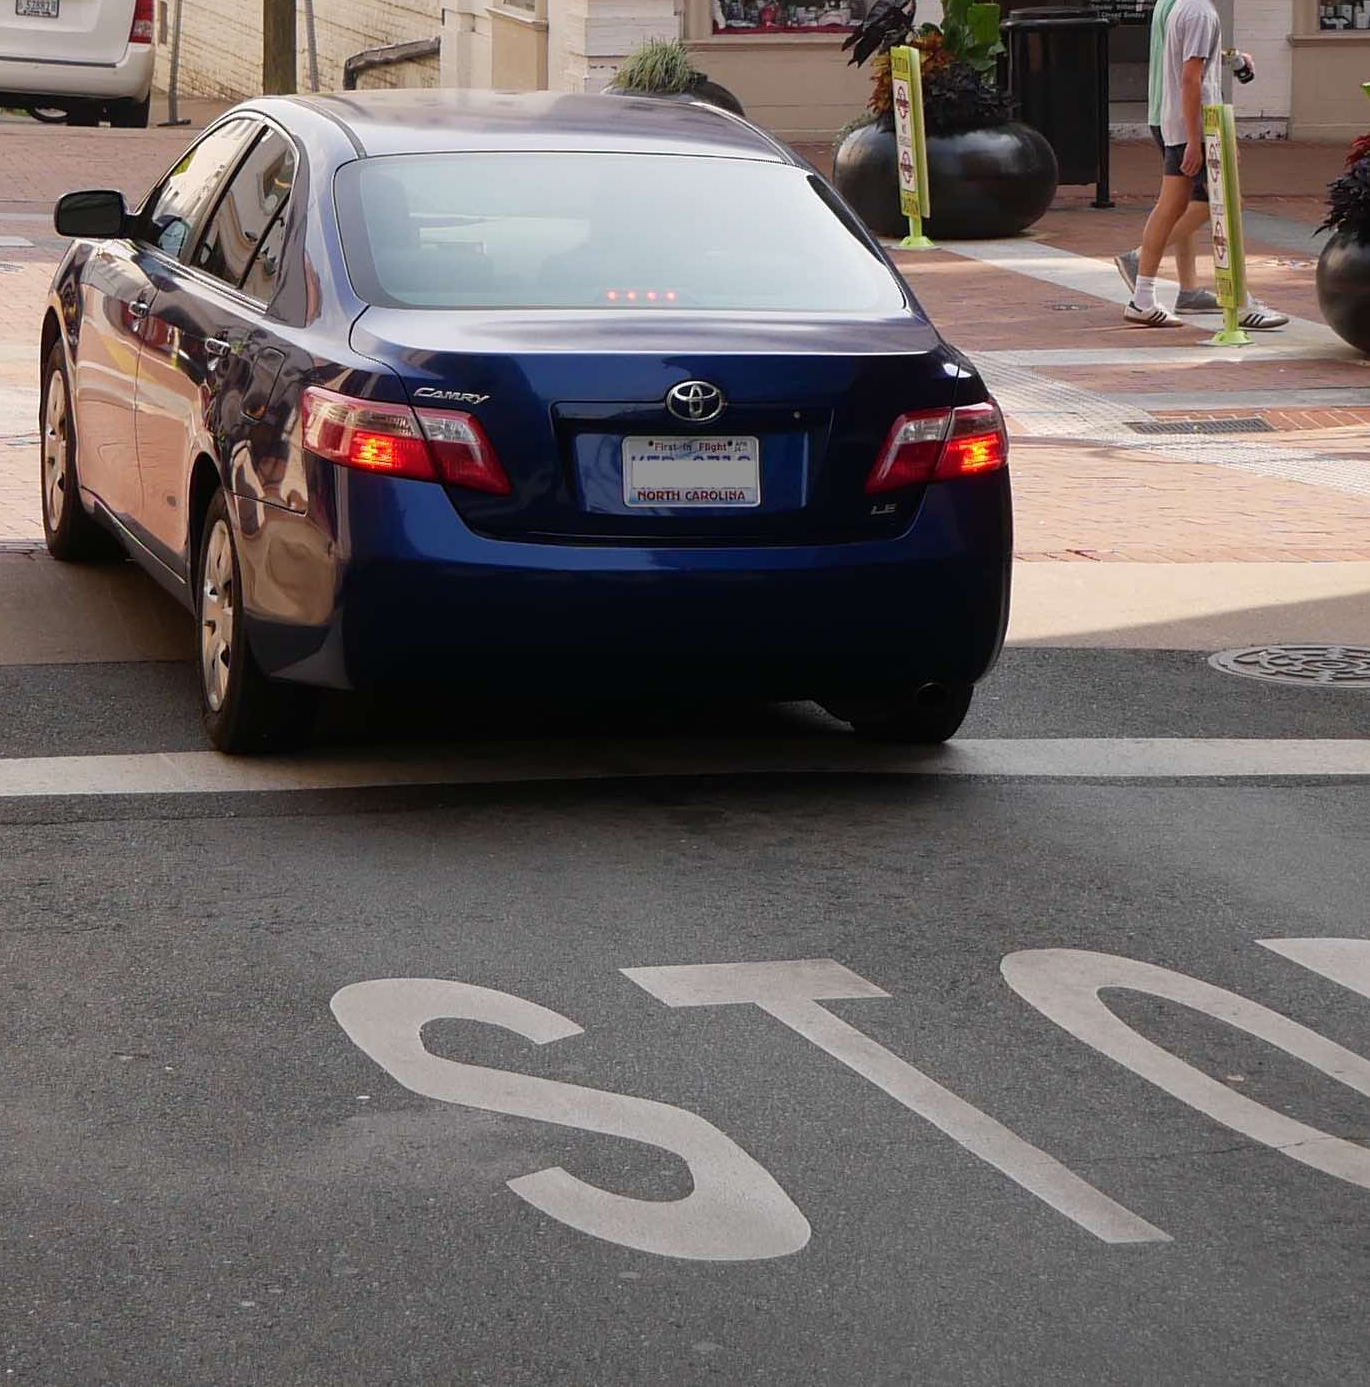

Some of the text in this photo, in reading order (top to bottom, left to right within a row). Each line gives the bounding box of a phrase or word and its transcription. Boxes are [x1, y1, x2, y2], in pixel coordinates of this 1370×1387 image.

[699, 442, 727, 453] Flight
[637, 491, 746, 501] NORTH CAROLINA
